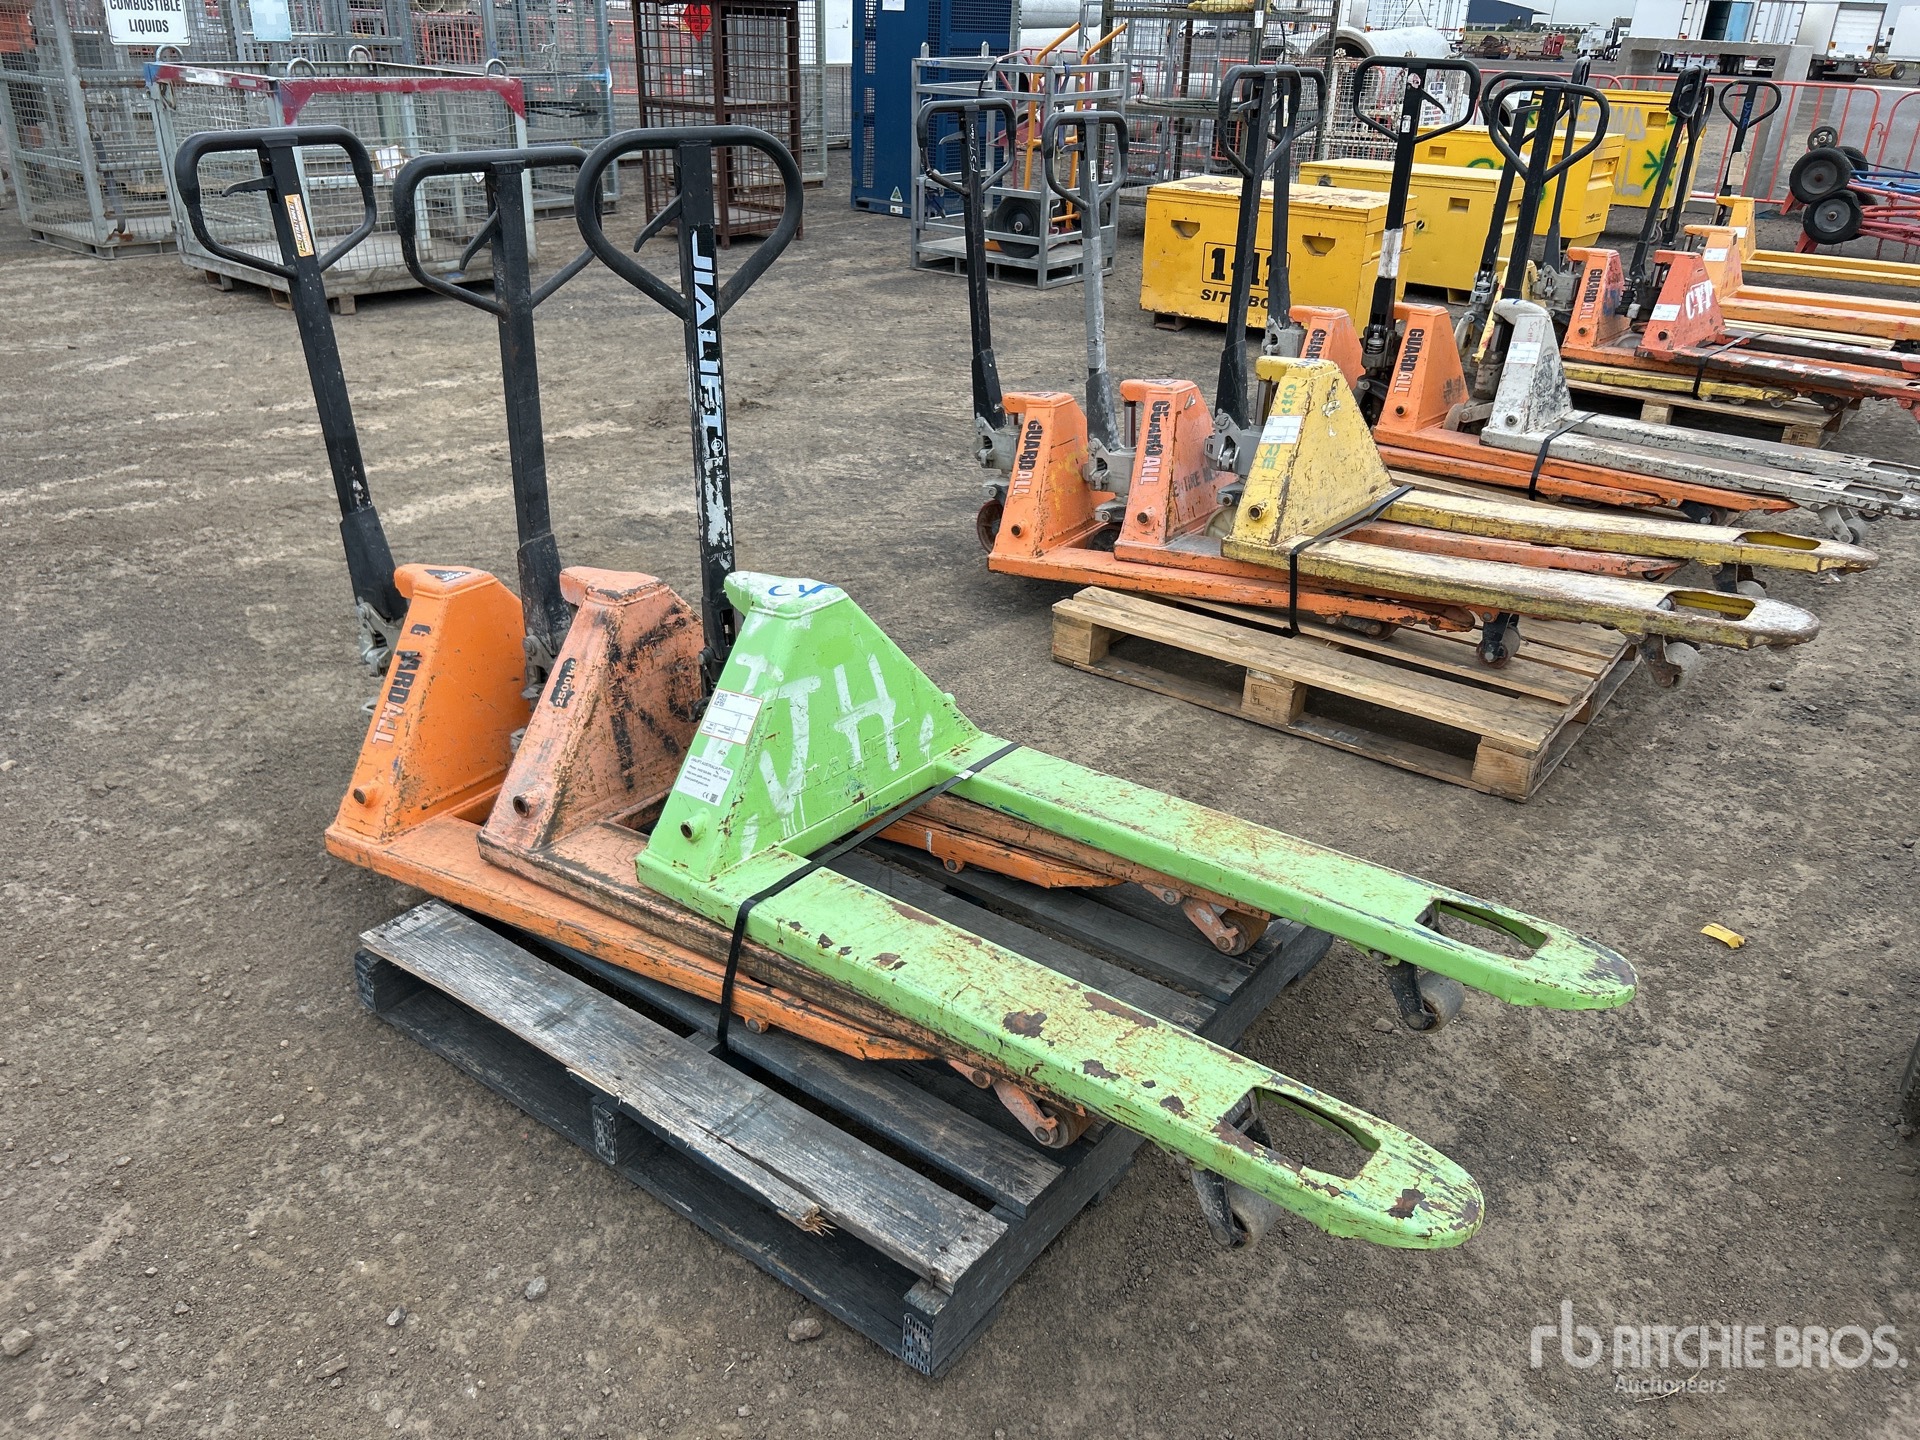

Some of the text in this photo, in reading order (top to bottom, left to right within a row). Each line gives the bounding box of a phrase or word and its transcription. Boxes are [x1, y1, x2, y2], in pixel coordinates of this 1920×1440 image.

[128, 19, 170, 35] LIQUIDS
[1578, 268, 1604, 321] GUARDALL
[1393, 328, 1425, 394] GUARDALL
[1012, 418, 1044, 496] GUARDALL
[371, 623, 432, 745] GARDALL
